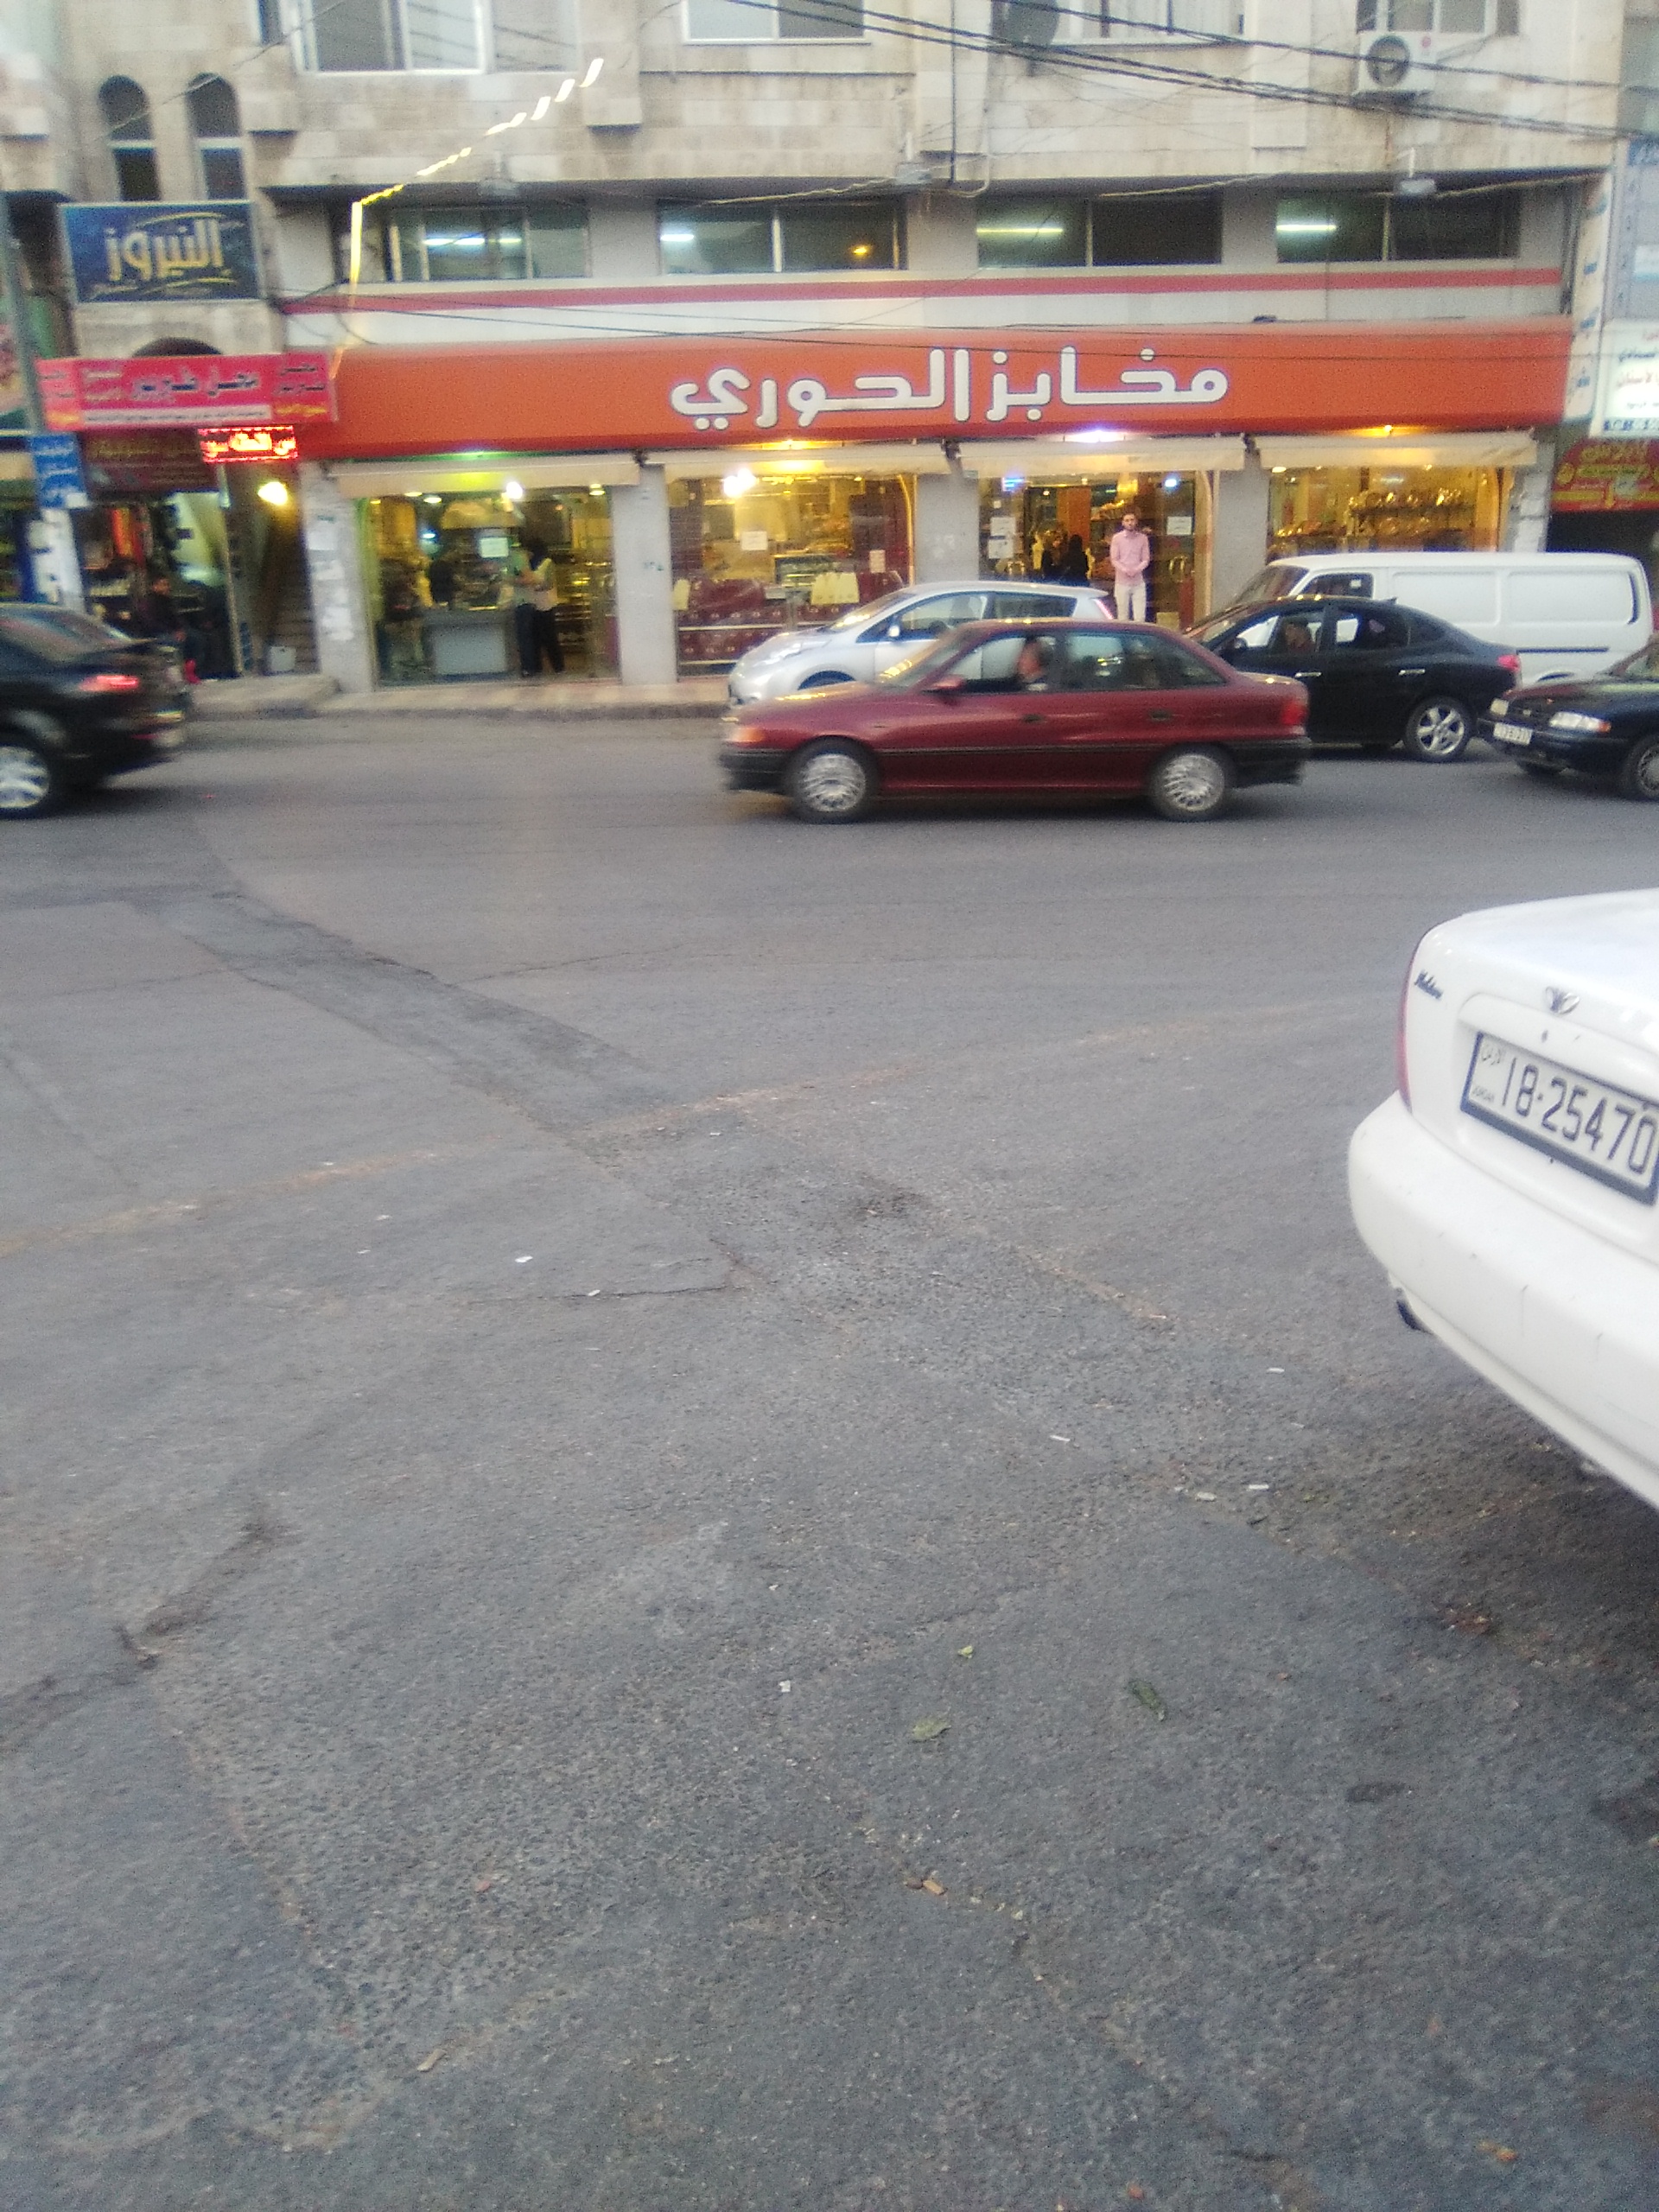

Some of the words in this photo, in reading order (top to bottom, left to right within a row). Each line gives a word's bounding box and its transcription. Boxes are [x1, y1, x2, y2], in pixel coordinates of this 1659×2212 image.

[104, 218, 225, 283] النيروز
[670, 347, 971, 429] الحوري
[985, 346, 1230, 422] مخابز
